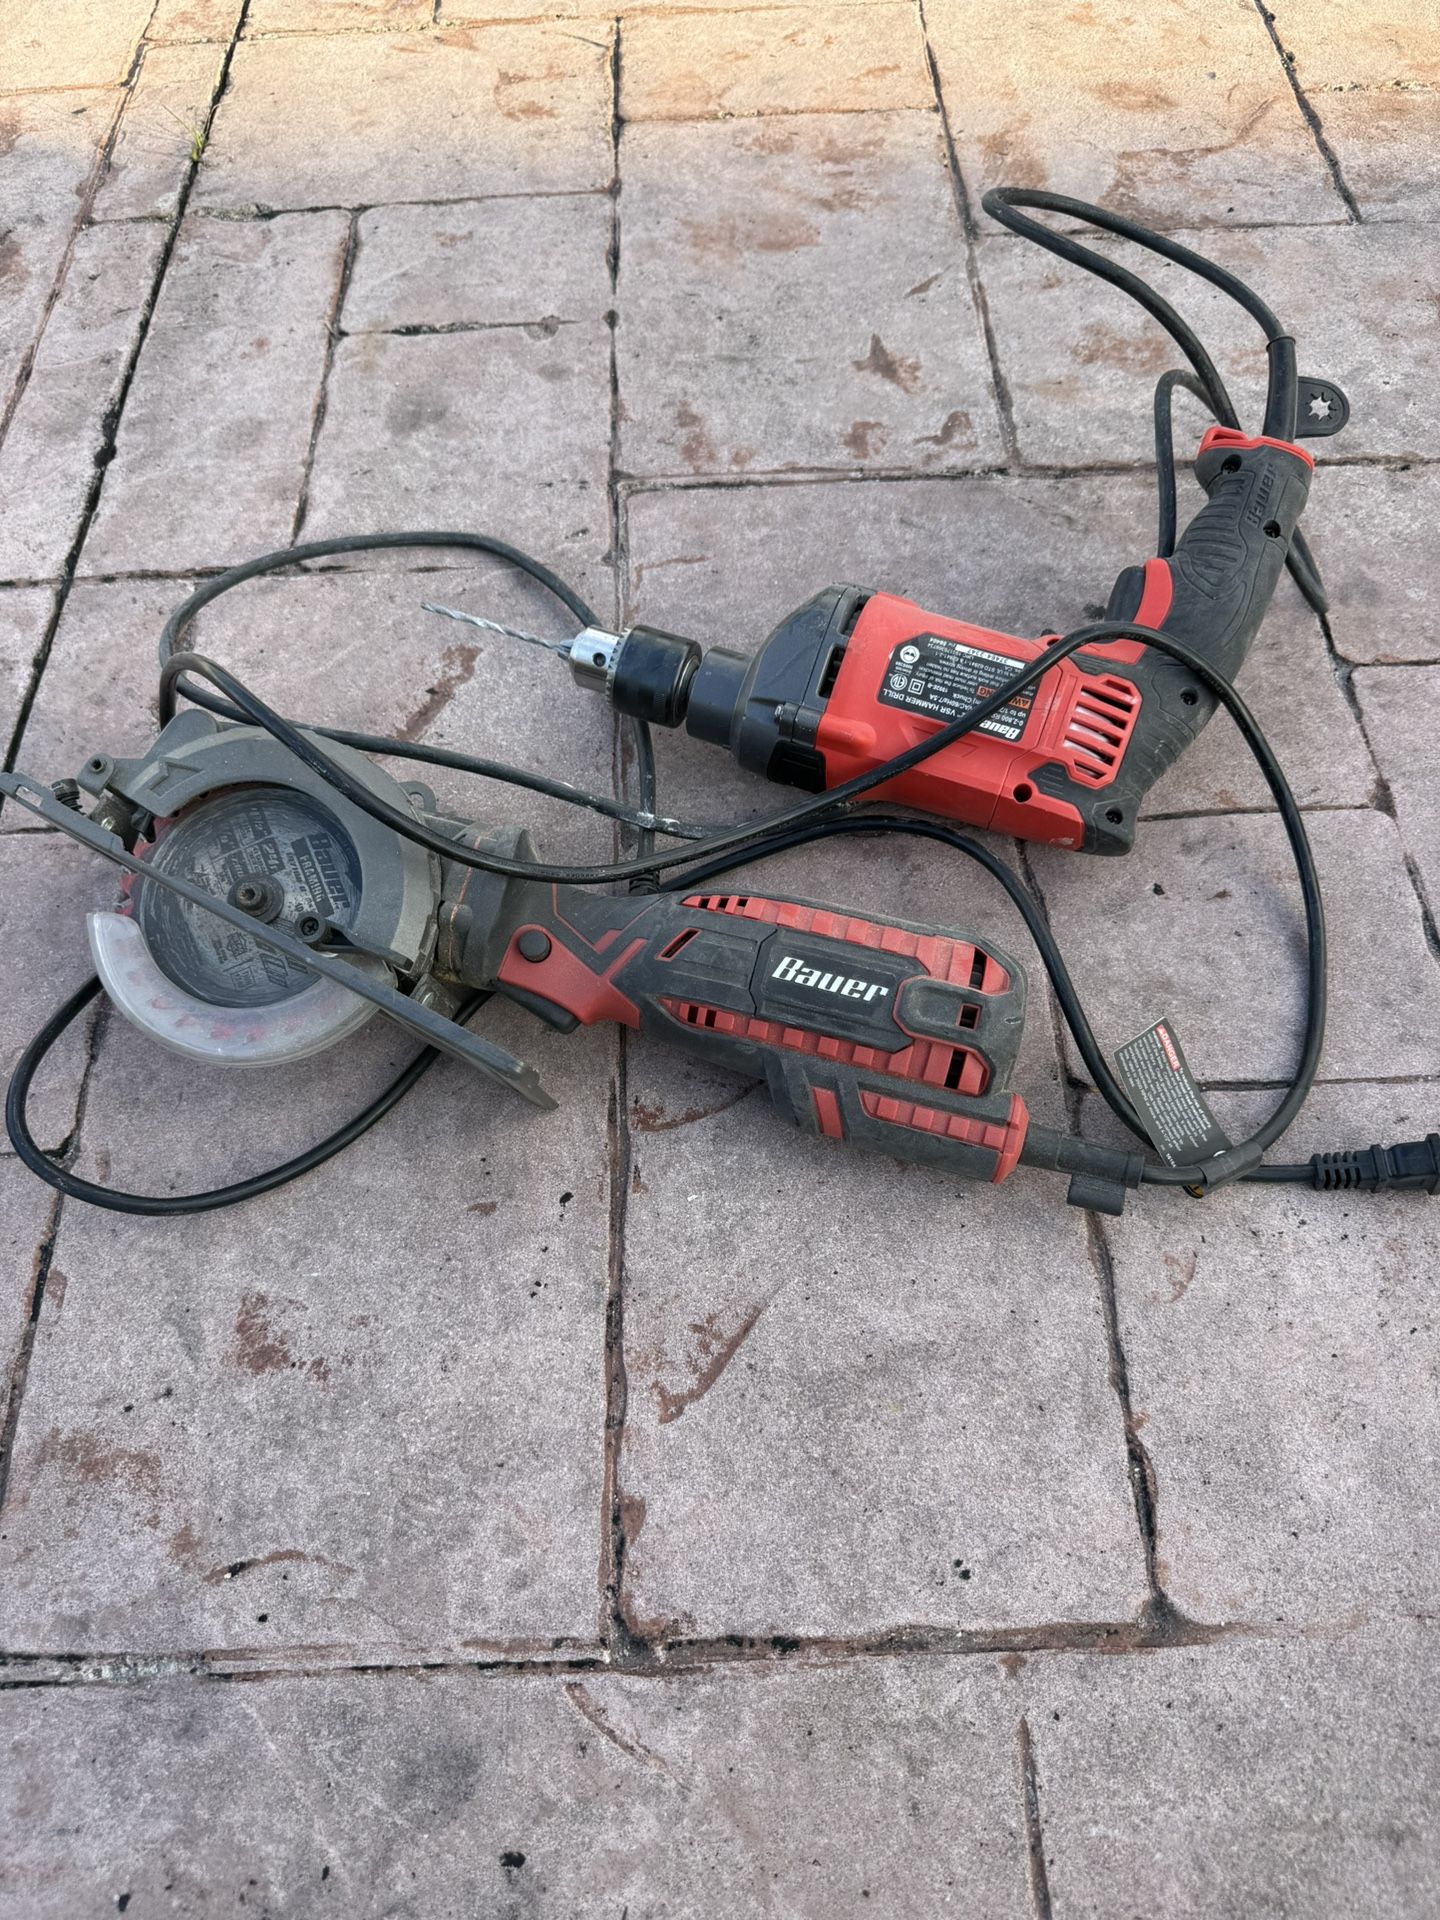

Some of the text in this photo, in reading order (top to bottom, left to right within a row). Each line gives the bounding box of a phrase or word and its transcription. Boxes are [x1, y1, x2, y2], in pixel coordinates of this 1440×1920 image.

[1243, 462, 1275, 528] Bauer
[882, 688, 904, 700] DRILL
[905, 695, 939, 711] HAMMER
[951, 692, 972, 702] Chuck
[939, 705, 956, 716] VSR
[1016, 708, 1027, 716] up
[979, 719, 1021, 739] Baue
[298, 853, 325, 903] FRAMING
[308, 832, 350, 909] Bauer
[772, 957, 889, 1002] Bauer
[1161, 1032, 1179, 1067] DANGER
